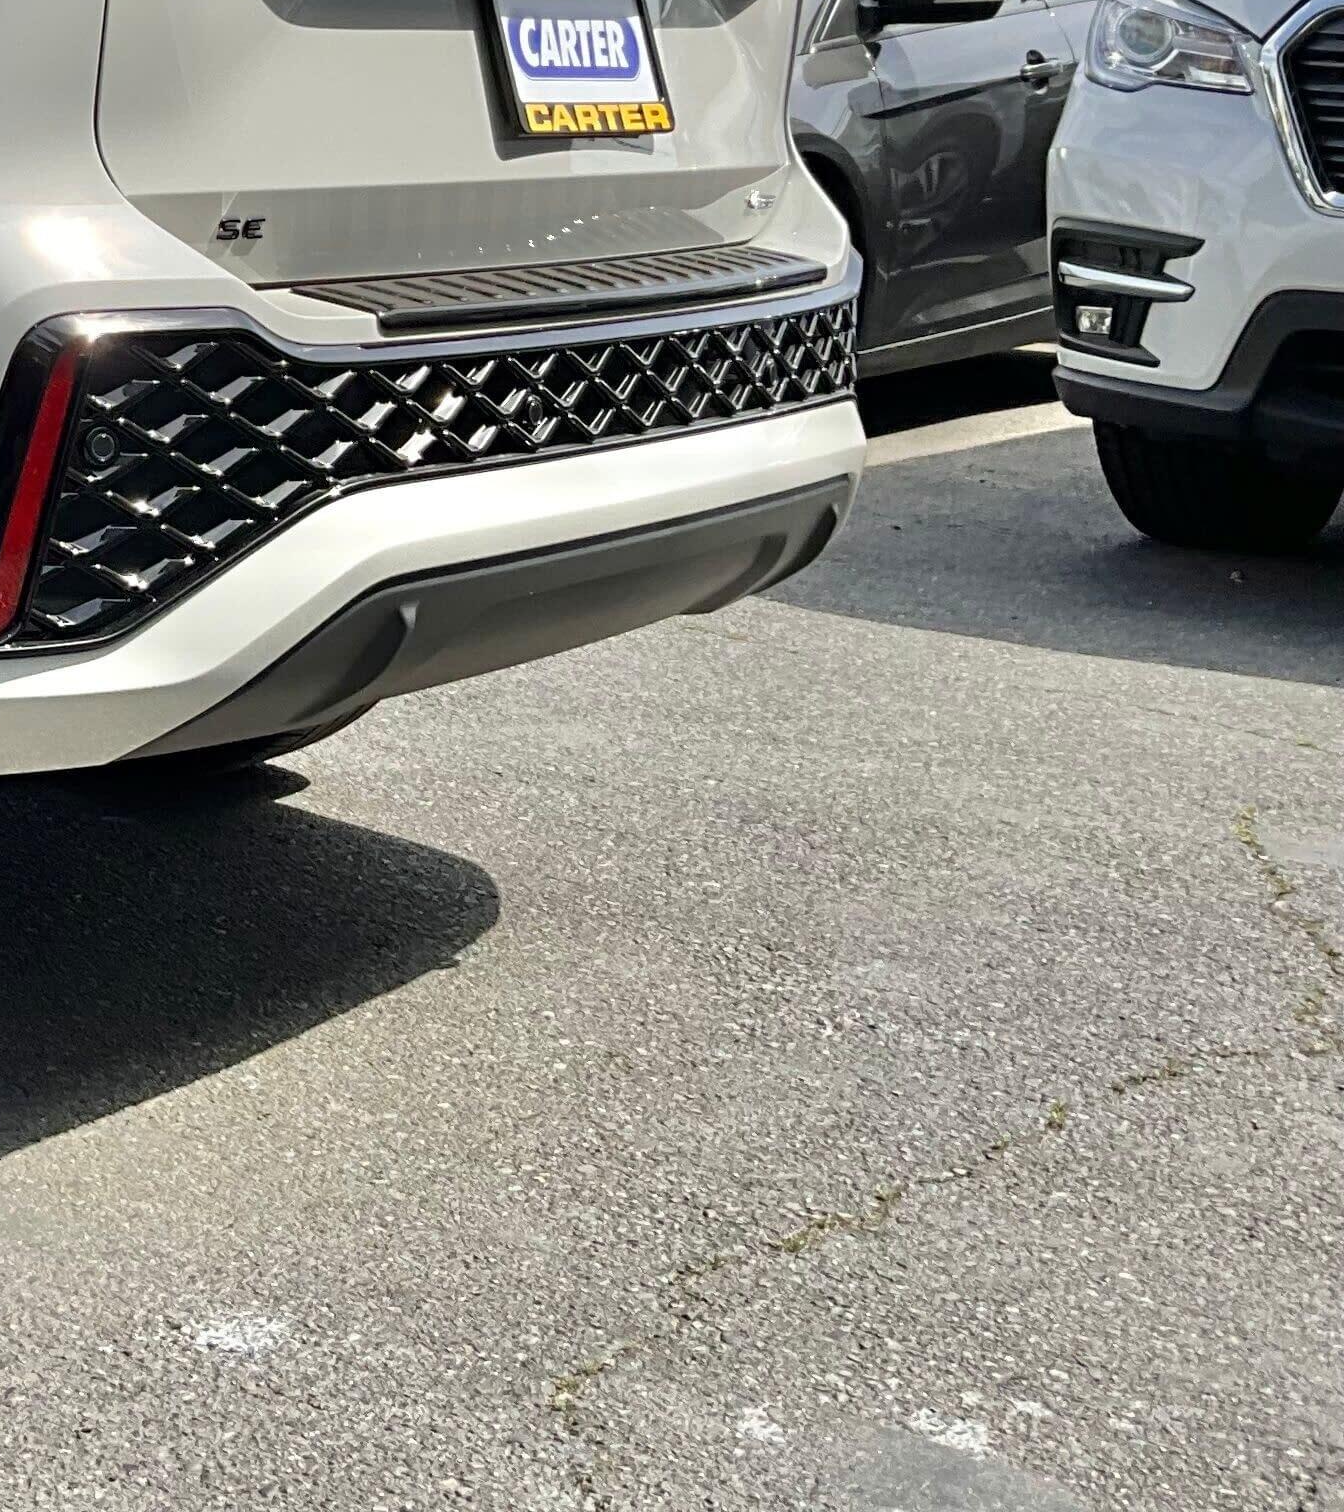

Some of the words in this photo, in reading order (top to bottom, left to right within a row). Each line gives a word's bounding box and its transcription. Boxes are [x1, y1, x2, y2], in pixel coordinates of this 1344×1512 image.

[519, 18, 629, 68] CARTER
[525, 103, 672, 132] CARTER
[216, 218, 266, 240] SE
